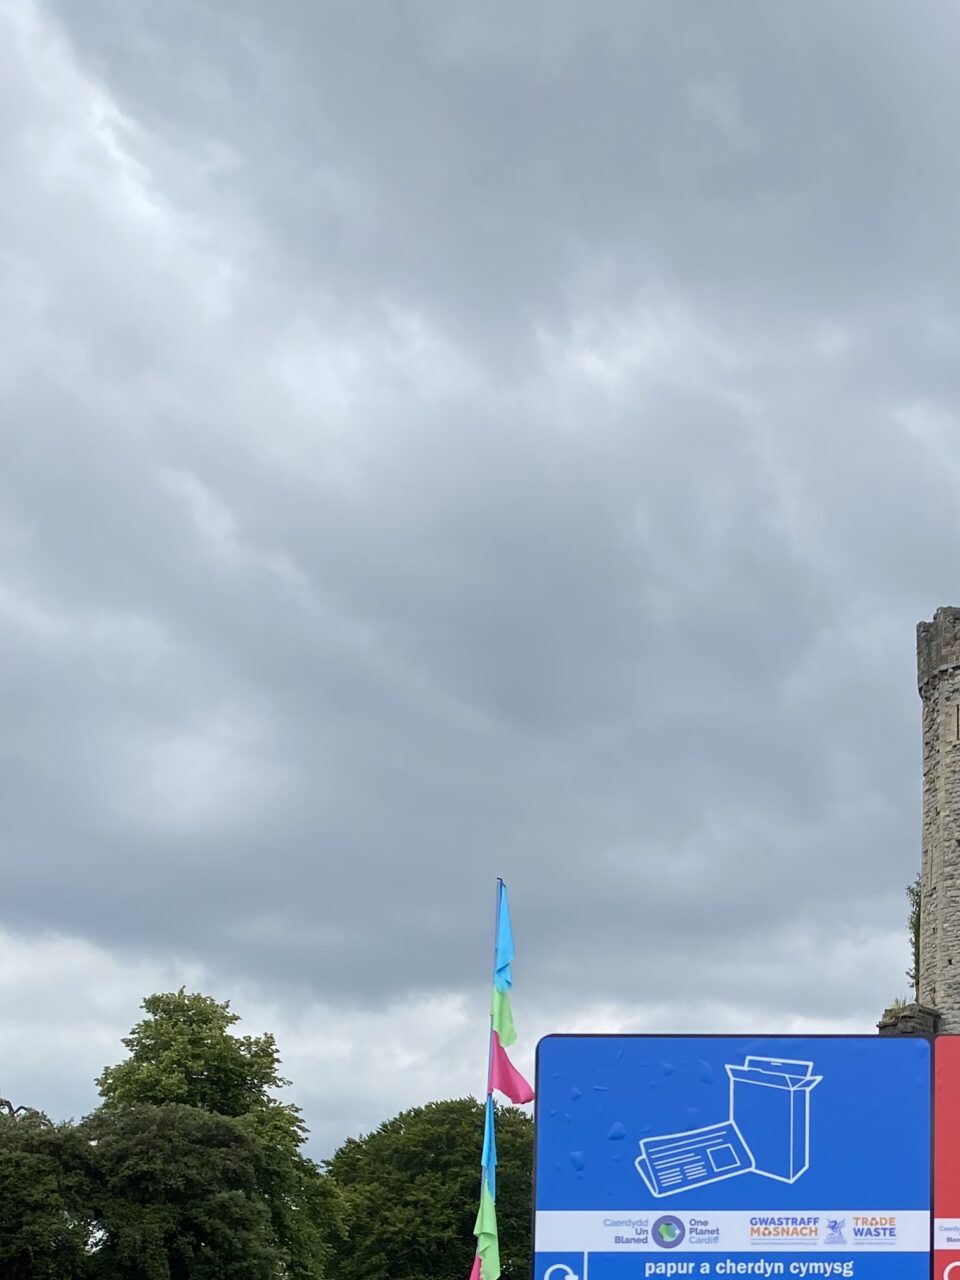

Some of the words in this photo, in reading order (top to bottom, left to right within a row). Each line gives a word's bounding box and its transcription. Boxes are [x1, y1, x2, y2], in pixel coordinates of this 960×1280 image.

[750, 1217, 820, 1226] GWASTRAFF
[853, 1227, 896, 1237] WASTE
[614, 1236, 648, 1244] Blaned
[645, 1262, 695, 1277] papur
[700, 1262, 710, 1274] a
[716, 1259, 784, 1277] cherdyn
[790, 1261, 854, 1277] cymysg
